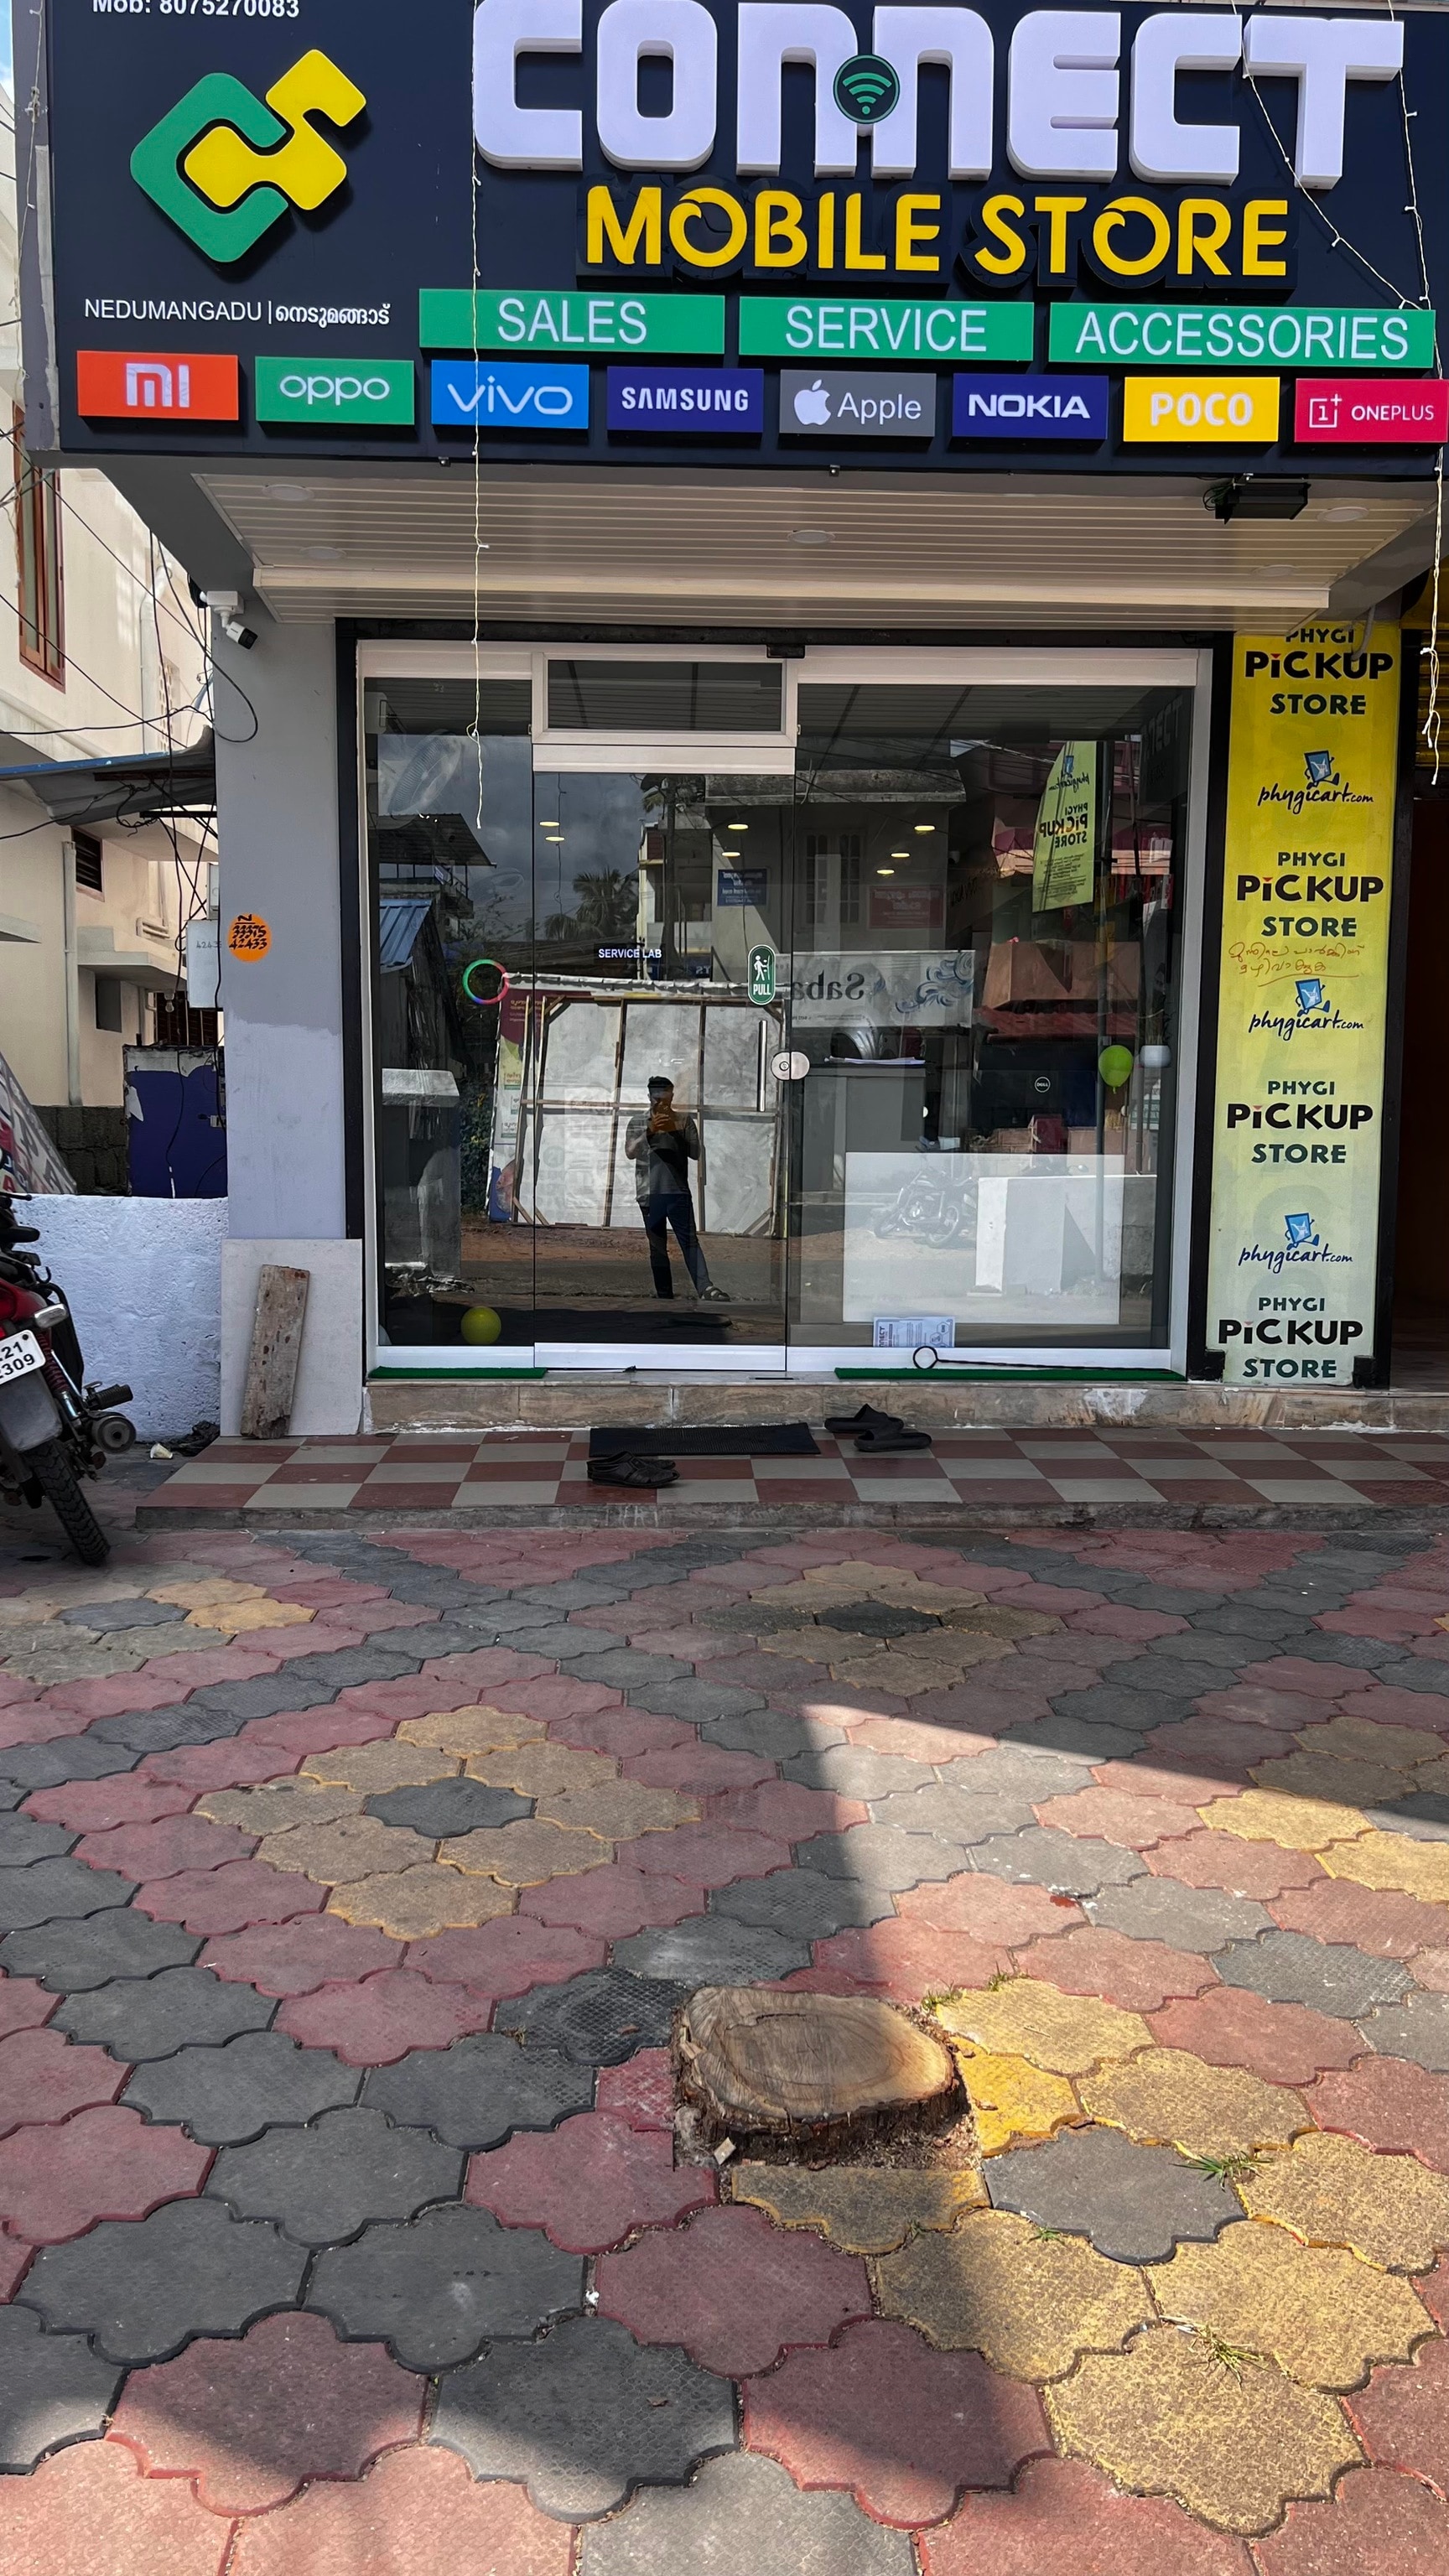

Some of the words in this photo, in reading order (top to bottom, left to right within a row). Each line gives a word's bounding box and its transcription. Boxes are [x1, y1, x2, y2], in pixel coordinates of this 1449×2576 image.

[92, 0, 151, 13] Mob:
[159, 0, 300, 18] 8075270083
[587, 186, 941, 272] MOBILE
[974, 195, 1288, 277] STORE
[85, 299, 262, 320] NEDUMANGADU
[497, 298, 647, 345] SALES
[785, 304, 988, 352] SERVICE
[1075, 311, 1409, 360] ACCESSORIES
[279, 376, 391, 405] oppo
[447, 375, 573, 415] vivo
[621, 387, 749, 412] SAMSUNG
[837, 392, 922, 420] Apple
[968, 393, 1090, 419] NOKIA
[1150, 392, 1253, 426] POCO
[1351, 405, 1434, 421] ONEPLUS
[1270, 693, 1367, 715] STORE
[1257, 782, 1374, 814] phygicart.com
[1278, 852, 1346, 866] PHYGI
[1261, 917, 1357, 937] STORE
[599, 948, 640, 958] SERVICE
[642, 948, 662, 958] LAB
[753, 984, 771, 995] PULL
[1249, 1010, 1364, 1041] phygicart.com
[1268, 1081, 1335, 1095] PHYGI
[1251, 1144, 1347, 1164] STORE
[1238, 1244, 1353, 1274] phygicart.com
[1259, 1297, 1326, 1311] PHYGI
[0, 1342, 23, 1362] 21
[0, 1353, 35, 1379] 309
[1243, 1358, 1337, 1378] STORE
